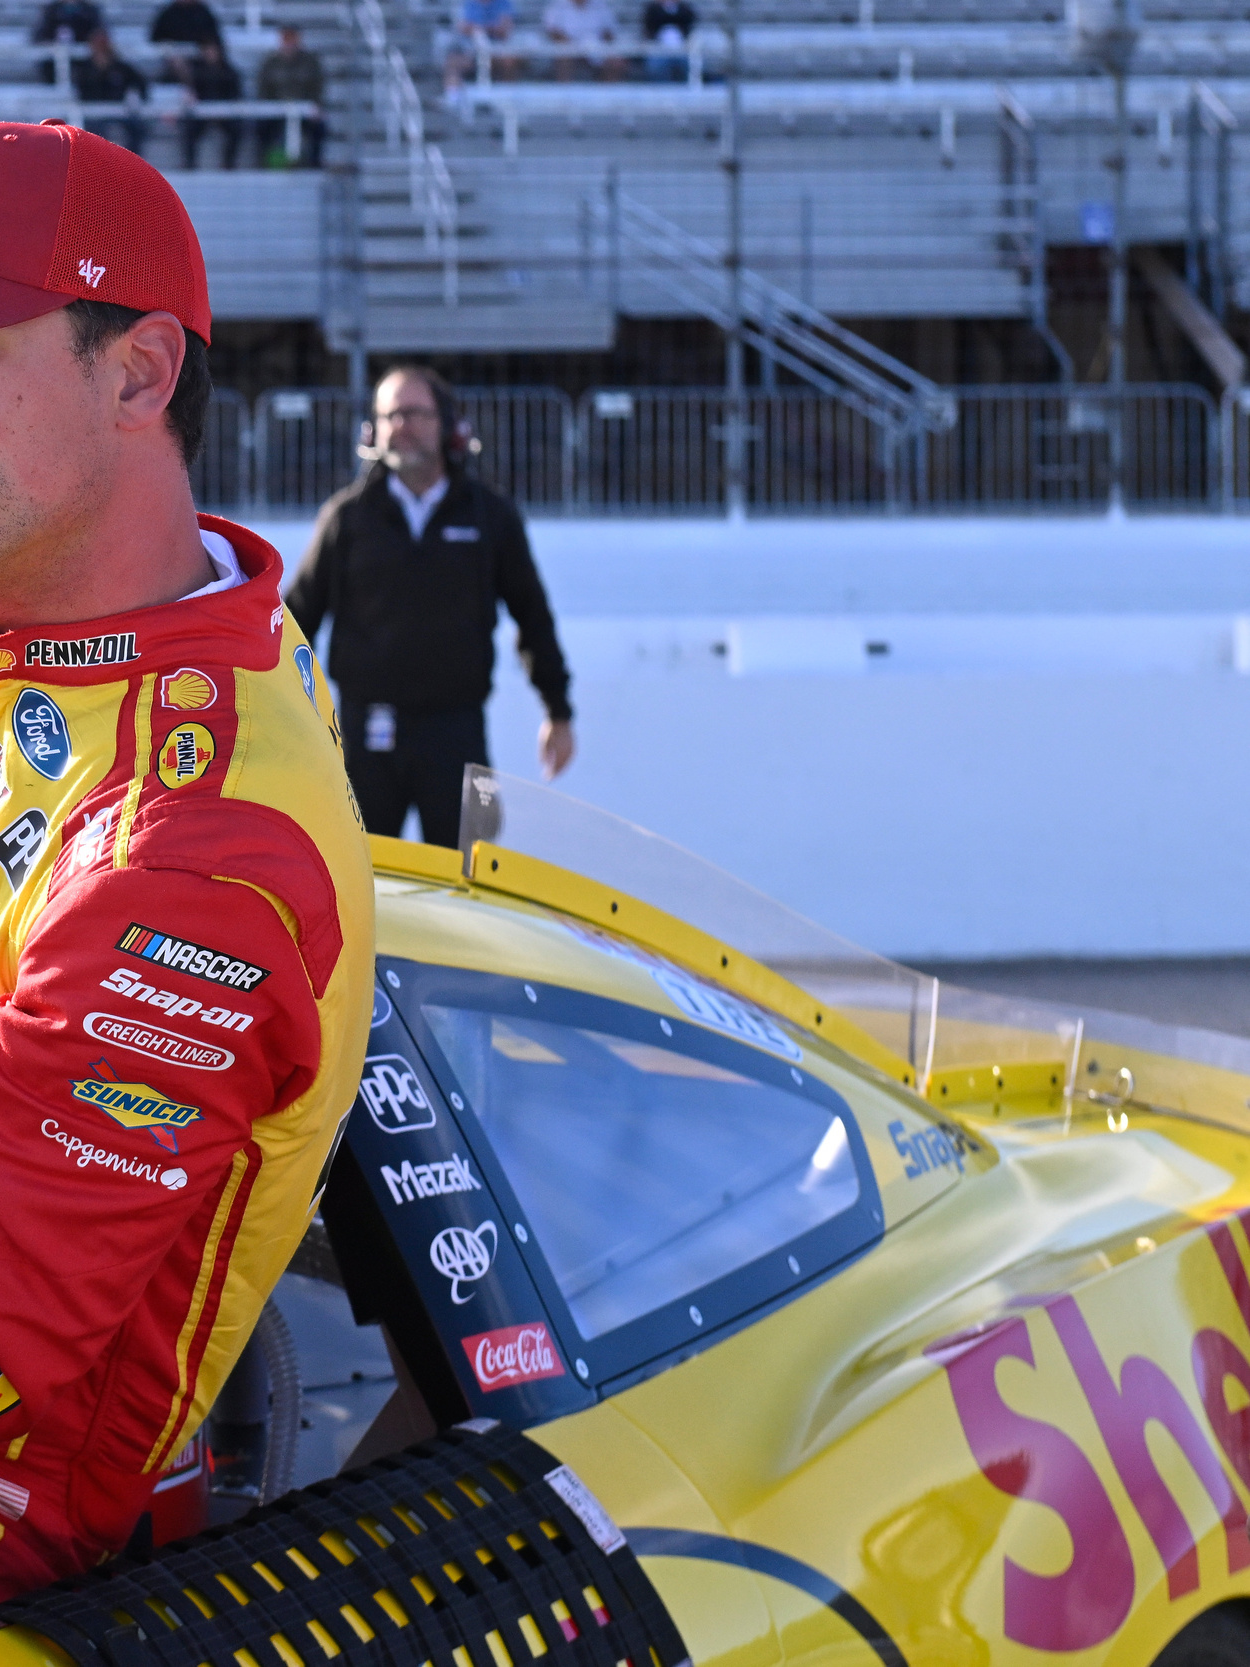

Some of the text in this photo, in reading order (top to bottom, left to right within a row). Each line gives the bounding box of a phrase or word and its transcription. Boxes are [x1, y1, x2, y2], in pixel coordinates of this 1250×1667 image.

[25, 632, 141, 667] PENNZOIL
[19, 703, 60, 762] Ford
[153, 937, 264, 990] NASCAR
[99, 967, 254, 1033] Snap-on
[96, 1019, 222, 1067] FREIGHTLINER
[77, 1080, 196, 1124] SUNOCO
[361, 1064, 428, 1122] PPG
[40, 1118, 162, 1184] Capgemini
[380, 1152, 482, 1205] Mazak
[430, 1226, 490, 1281] AAA
